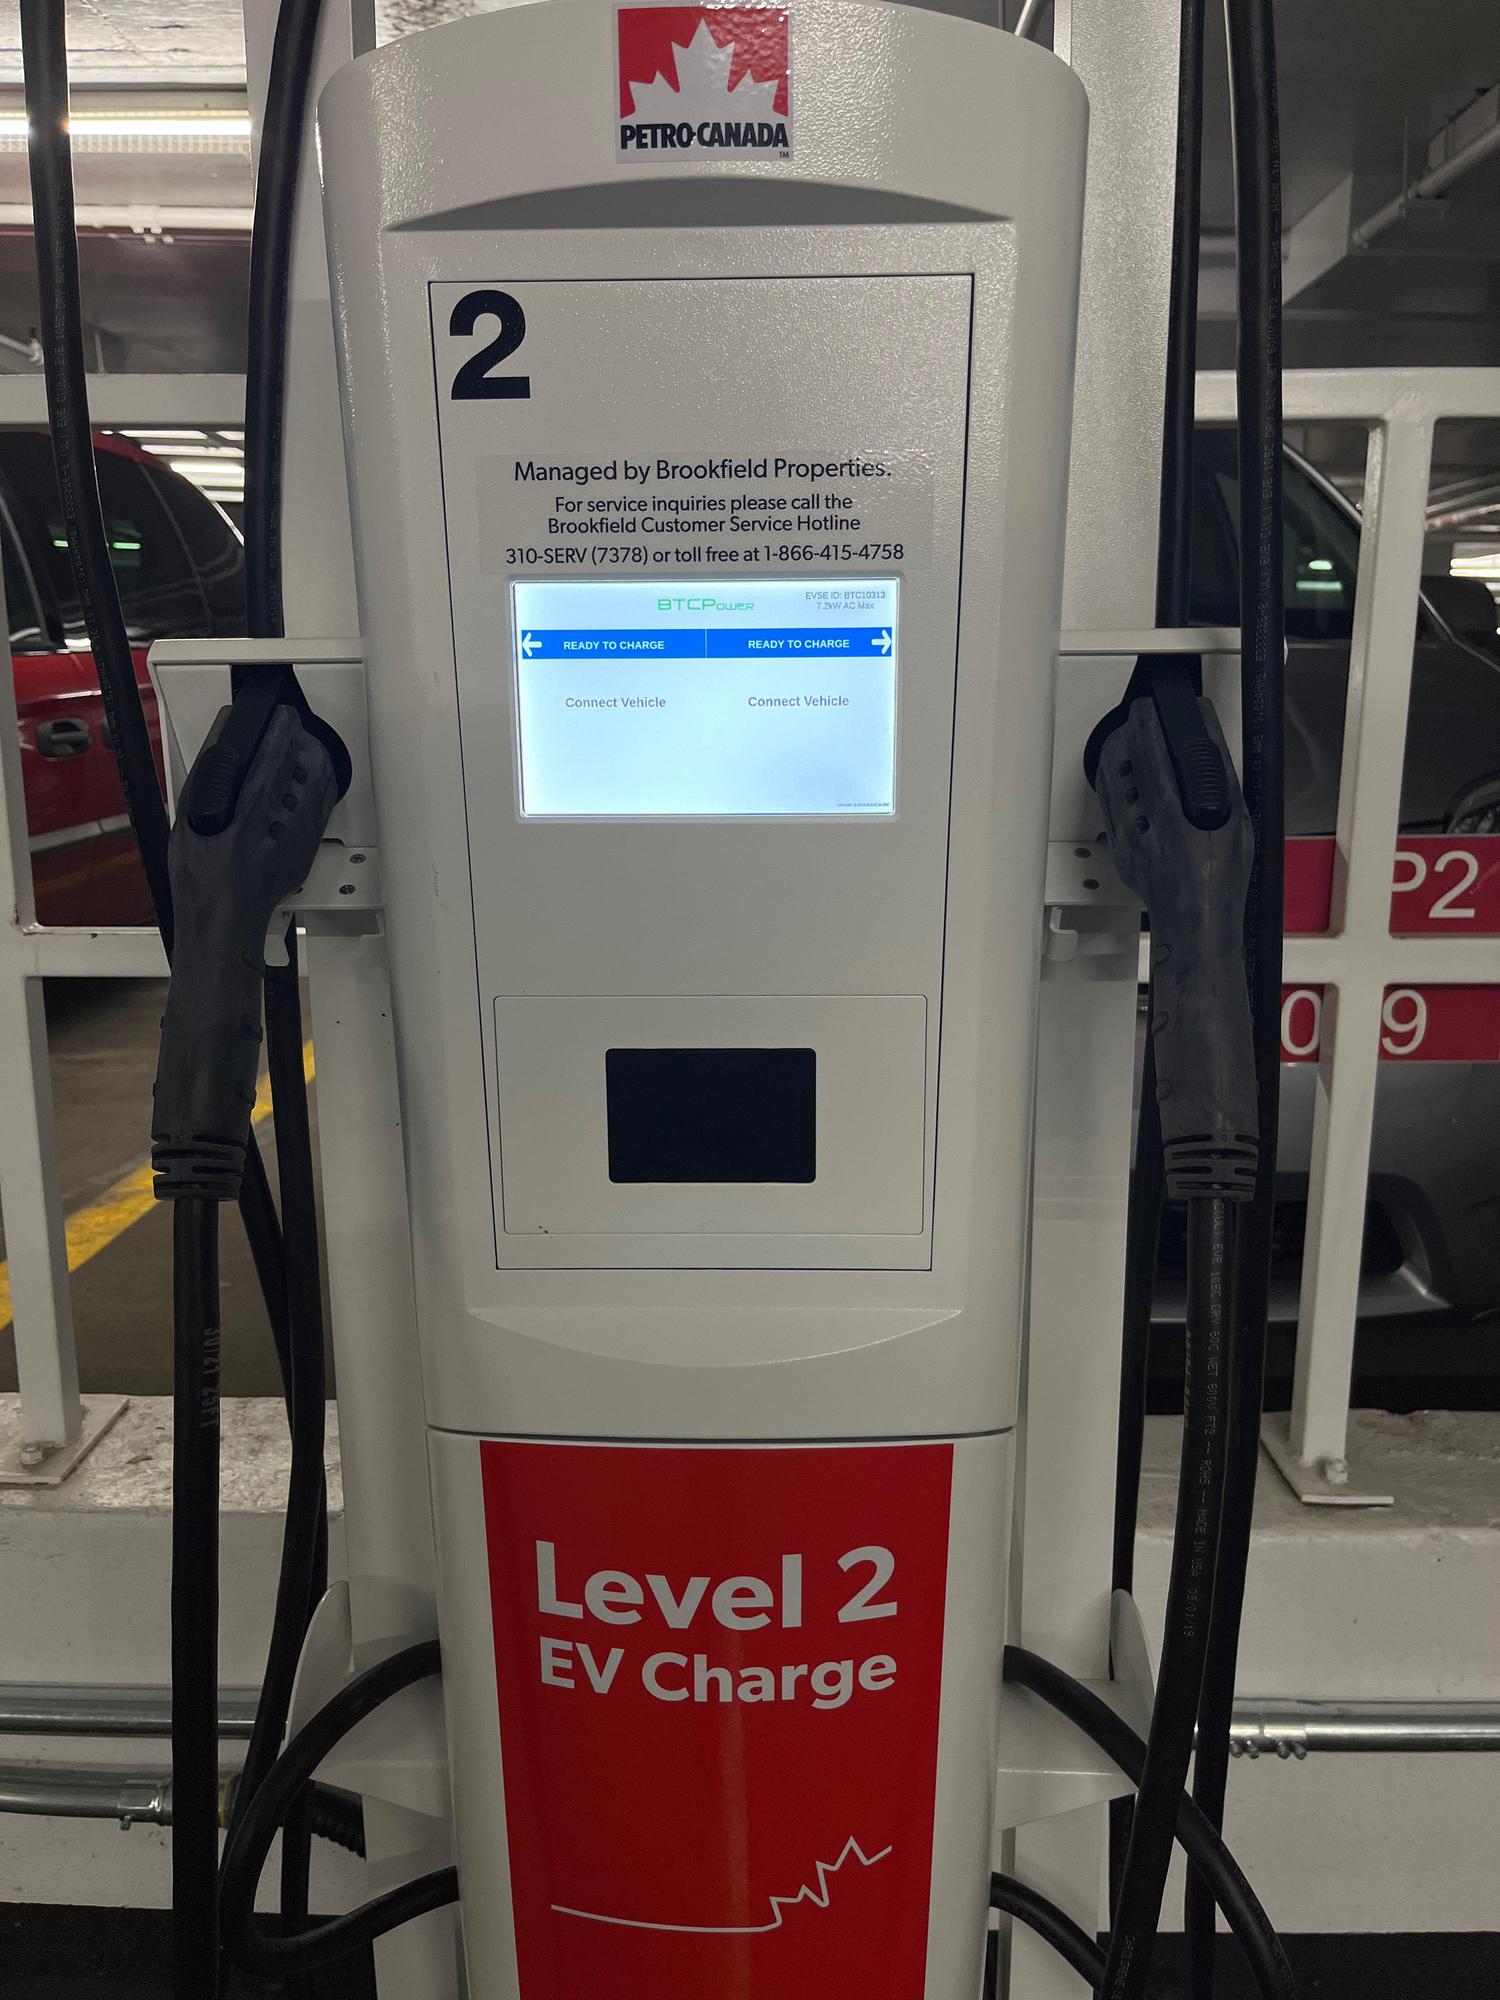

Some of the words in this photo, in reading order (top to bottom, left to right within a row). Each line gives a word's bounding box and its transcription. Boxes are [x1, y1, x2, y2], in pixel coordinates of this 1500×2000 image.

[450, 289, 531, 400] 2
[514, 460, 618, 486] Managed
[624, 460, 652, 485] by
[656, 458, 768, 480] Brookfield
[774, 456, 893, 482] Properties.
[555, 496, 584, 513] For
[586, 496, 649, 513] service
[651, 495, 727, 516] inquiries
[730, 494, 788, 517] please
[790, 493, 820, 511] call
[823, 493, 854, 510] the
[547, 516, 637, 535] Brookfield
[640, 515, 727, 534] Customer
[729, 514, 793, 533] Service
[797, 513, 861, 532] Hotline
[505, 547, 588, 565] 310-SERV
[591, 545, 649, 567] (7378)
[652, 549, 672, 563] or
[674, 546, 702, 563] toll
[704, 545, 740, 563] free
[743, 547, 761, 562] at
[763, 544, 905, 562] 1-866-415-4758
[805, 591, 829, 600] EVSE
[830, 591, 842, 600] ID:
[843, 601, 856, 610] AC
[857, 601, 875, 610] Max
[563, 641, 600, 650] READY
[602, 641, 617, 650] TO
[619, 640, 665, 650] CHARGE
[748, 640, 785, 649] READY
[787, 639, 802, 649] TO
[804, 639, 850, 649] CHARGE
[565, 697, 618, 708] Connect
[620, 696, 667, 708] Vehicle
[747, 696, 801, 707] Connect
[803, 695, 850, 707] Vehicle
[535, 1540, 803, 1630] Level
[837, 1545, 898, 1624] 2
[539, 1636, 625, 1694] EV
[641, 1651, 898, 1709] Charge
